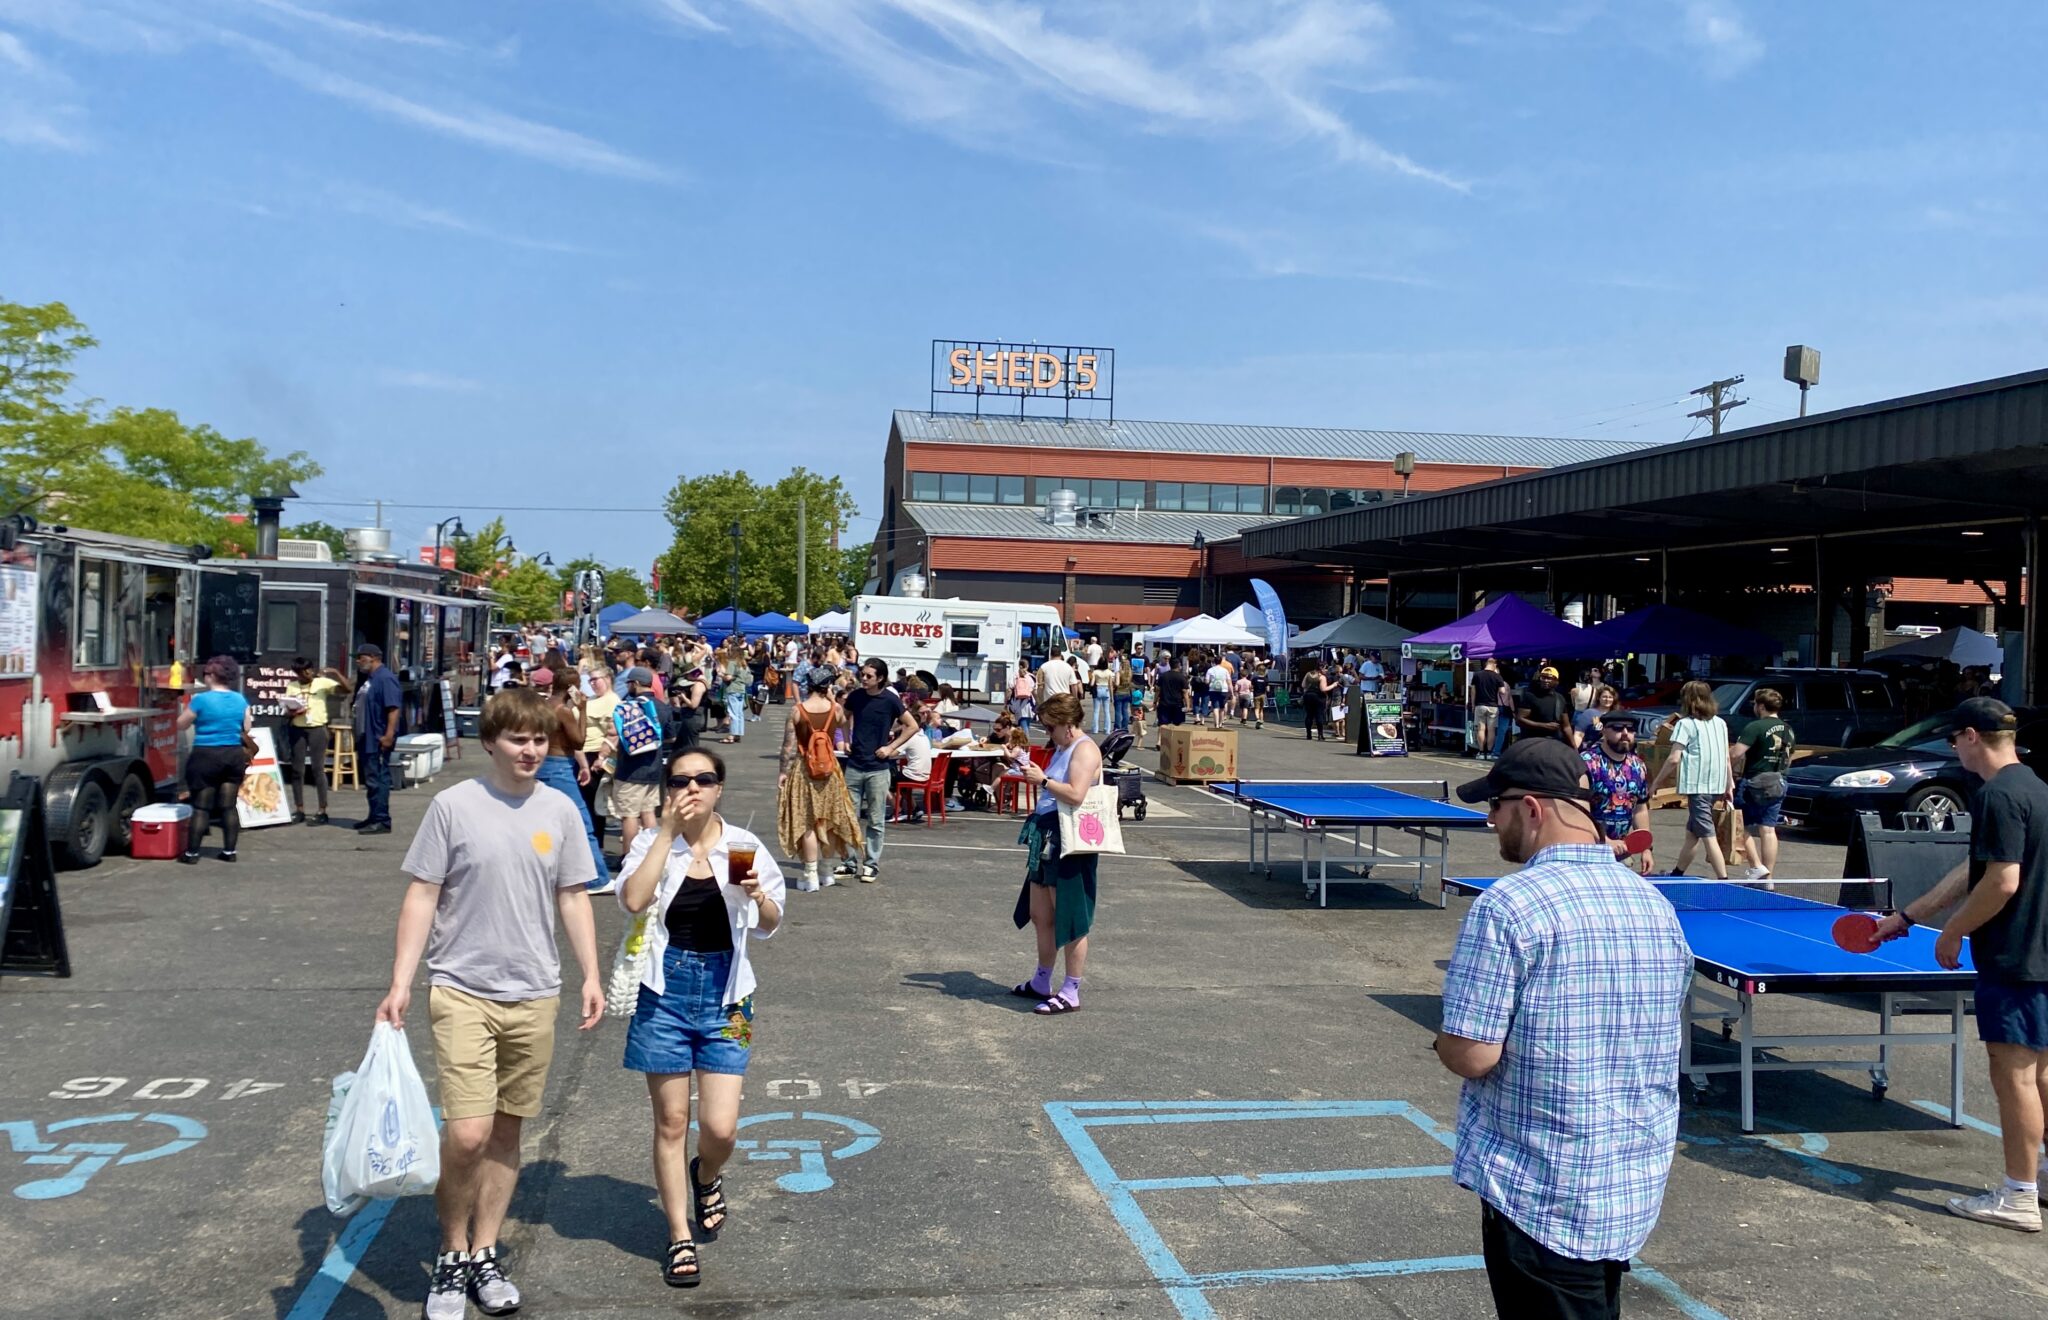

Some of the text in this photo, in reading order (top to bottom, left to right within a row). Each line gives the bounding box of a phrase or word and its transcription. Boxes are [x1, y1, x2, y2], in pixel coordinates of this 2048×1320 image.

[950, 348, 1097, 391] SHED 5
[860, 621, 943, 638] BEIGNETS
[260, 668, 274, 676] We
[247, 679, 281, 688] Special
[258, 690, 267, 699] &
[1717, 972, 1722, 982] 8
[1758, 982, 1766, 993] 8
